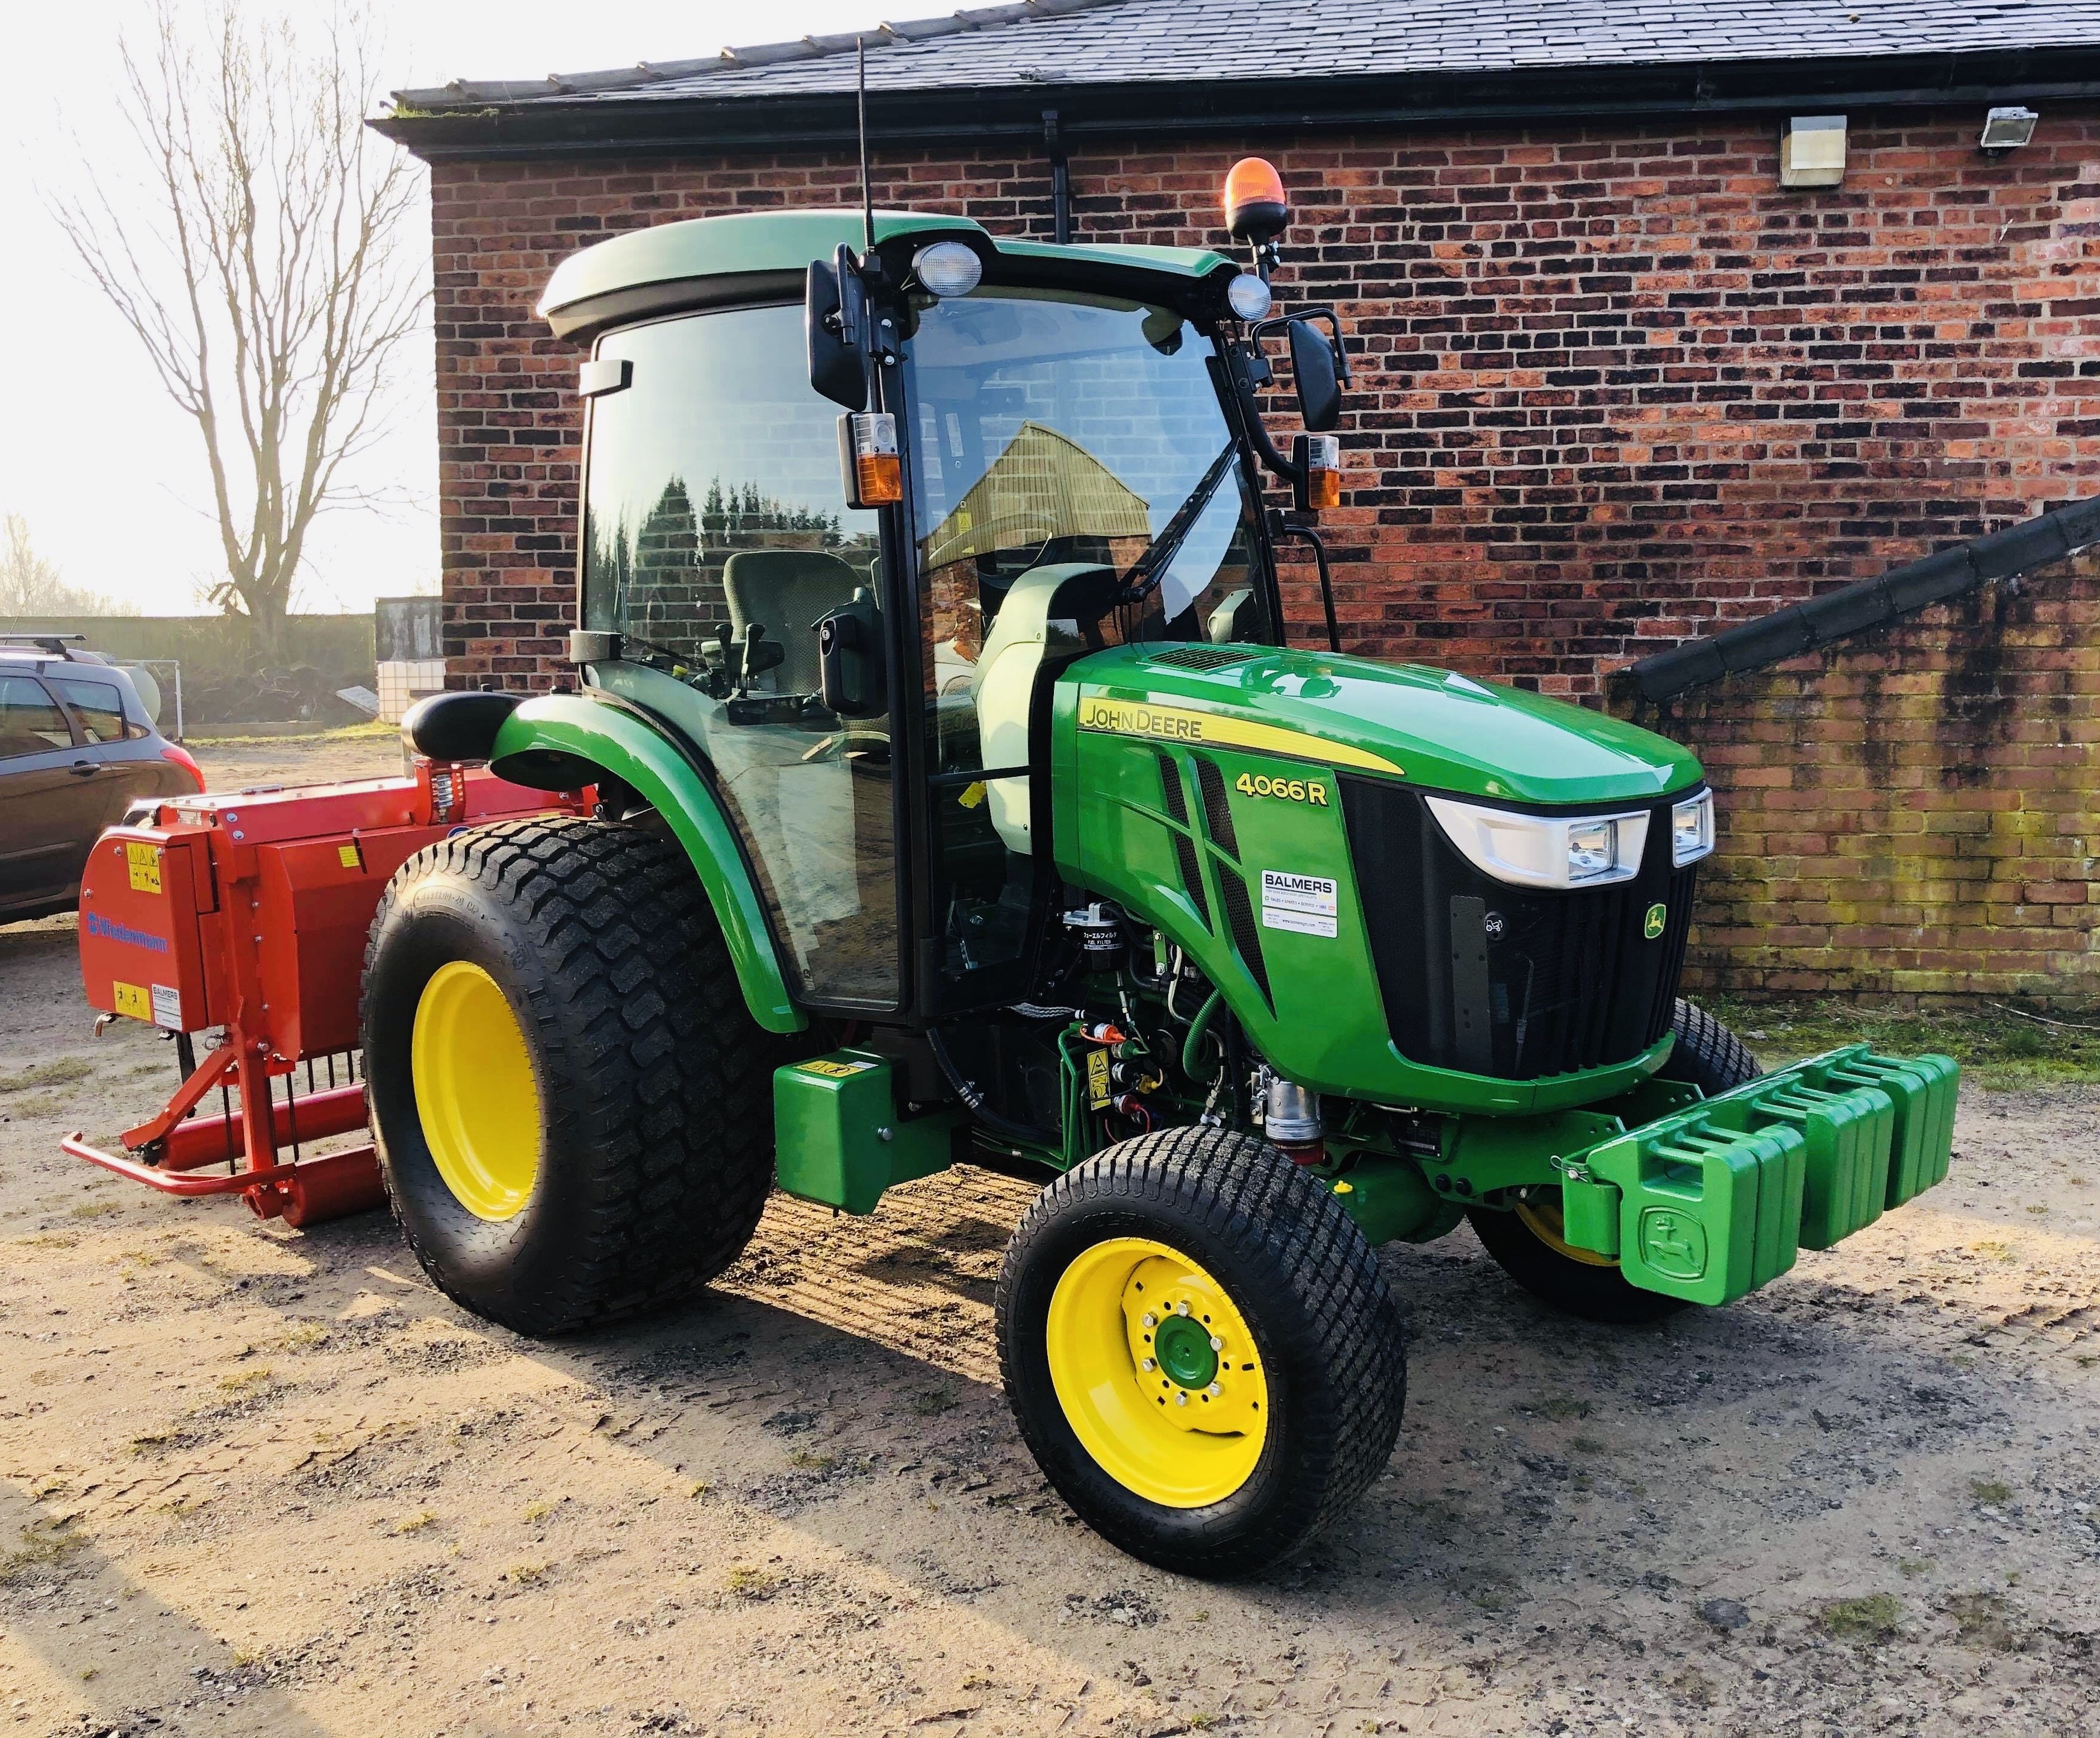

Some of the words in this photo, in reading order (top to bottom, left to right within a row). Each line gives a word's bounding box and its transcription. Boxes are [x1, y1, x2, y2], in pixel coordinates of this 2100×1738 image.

[1086, 705, 1133, 729] JOHN
[1136, 709, 1202, 738] DEERE
[1235, 772, 1329, 806] 4066R
[1265, 874, 1332, 893] BALMERS
